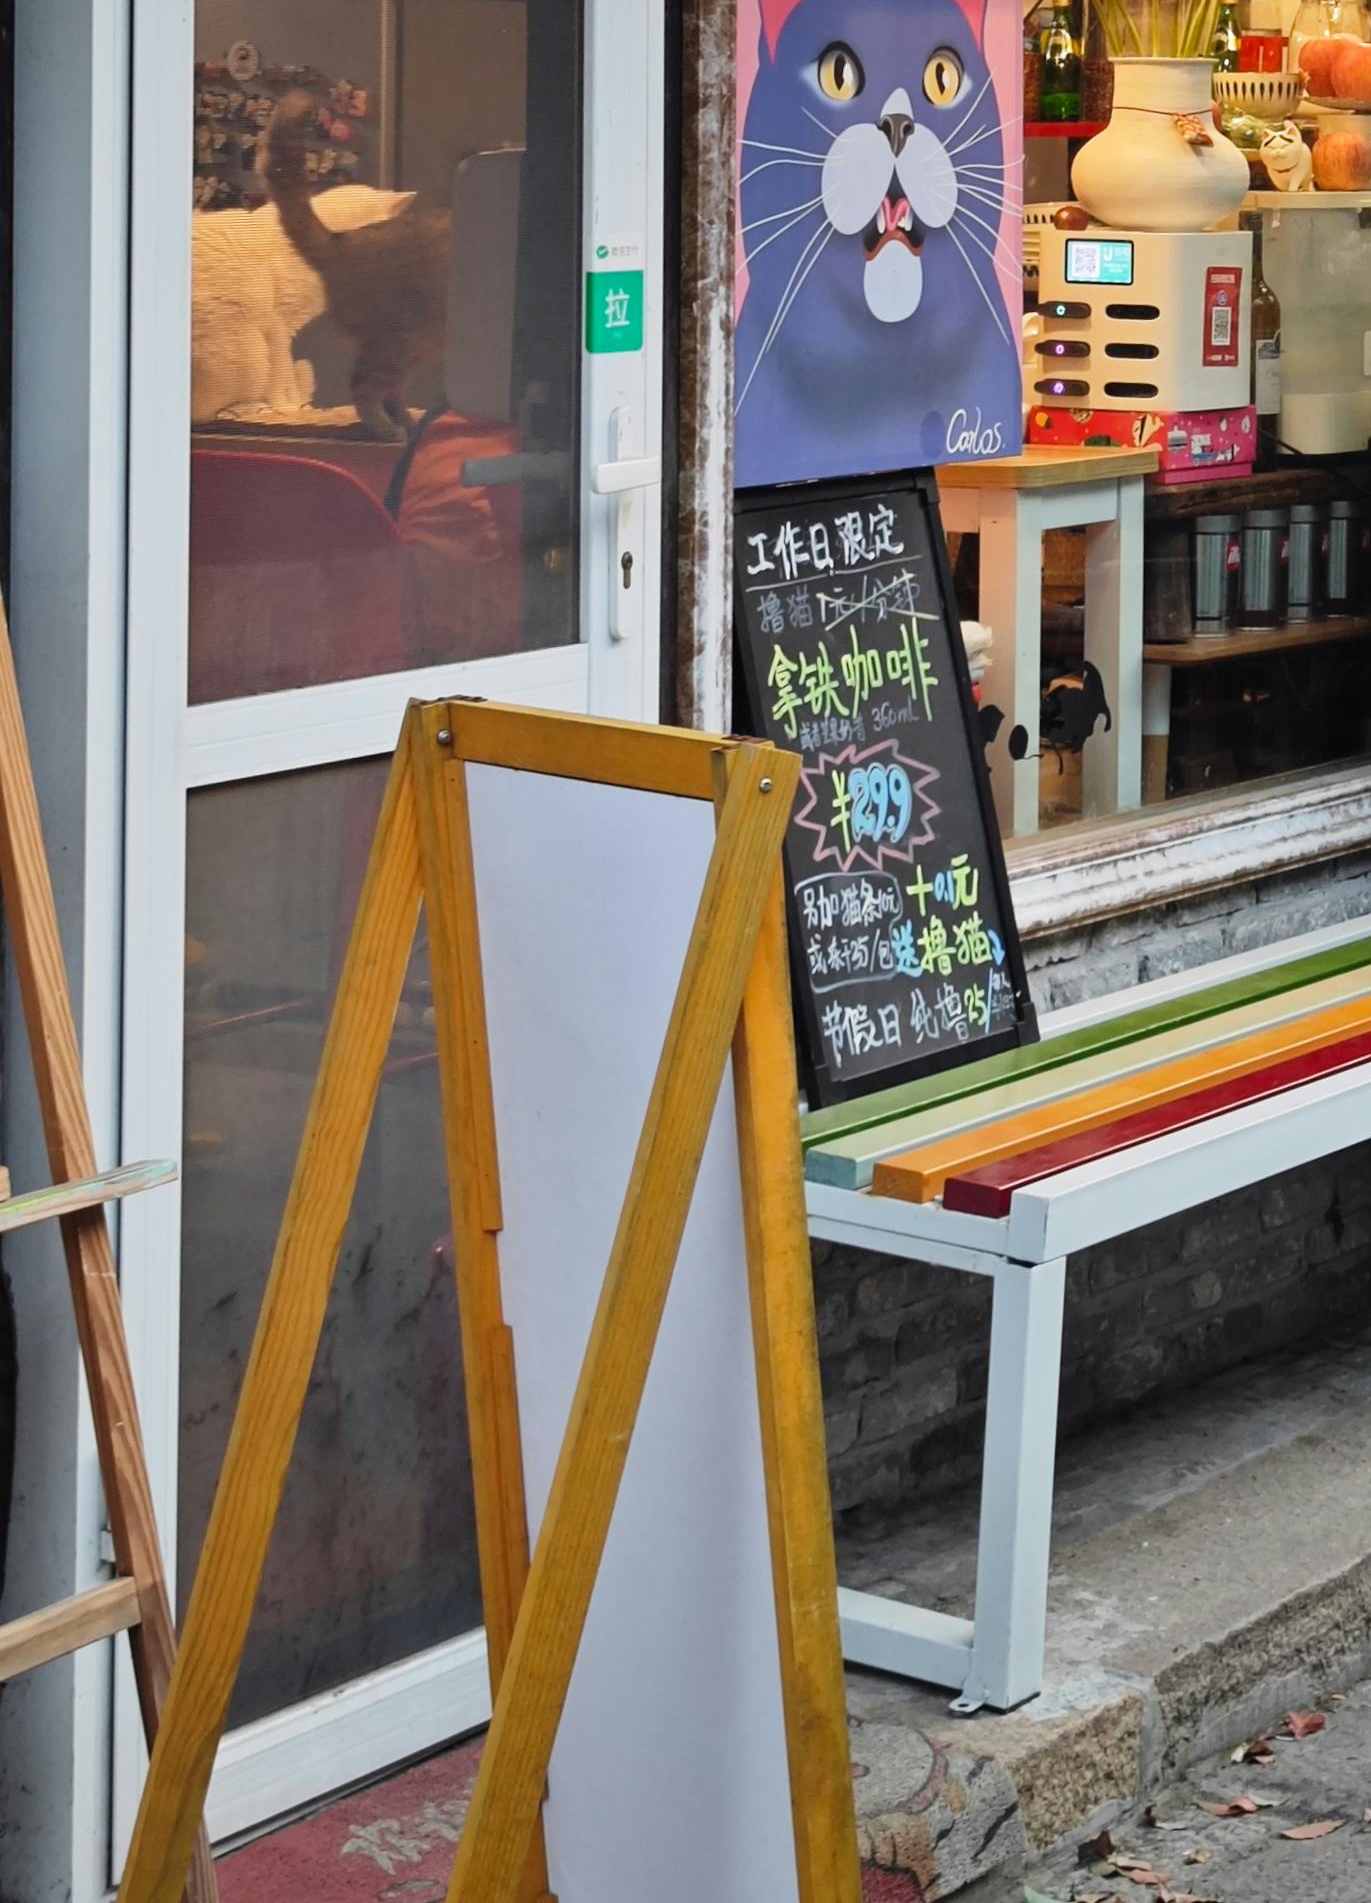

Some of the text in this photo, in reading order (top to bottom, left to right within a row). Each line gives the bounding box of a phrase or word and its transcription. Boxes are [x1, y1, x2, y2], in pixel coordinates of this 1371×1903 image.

[604, 287, 631, 329] 拉
[747, 503, 904, 581] 工作日限定
[767, 616, 940, 740] 拿铁咖啡
[830, 761, 912, 854] ¥29.9
[891, 910, 993, 978] 送撸猫
